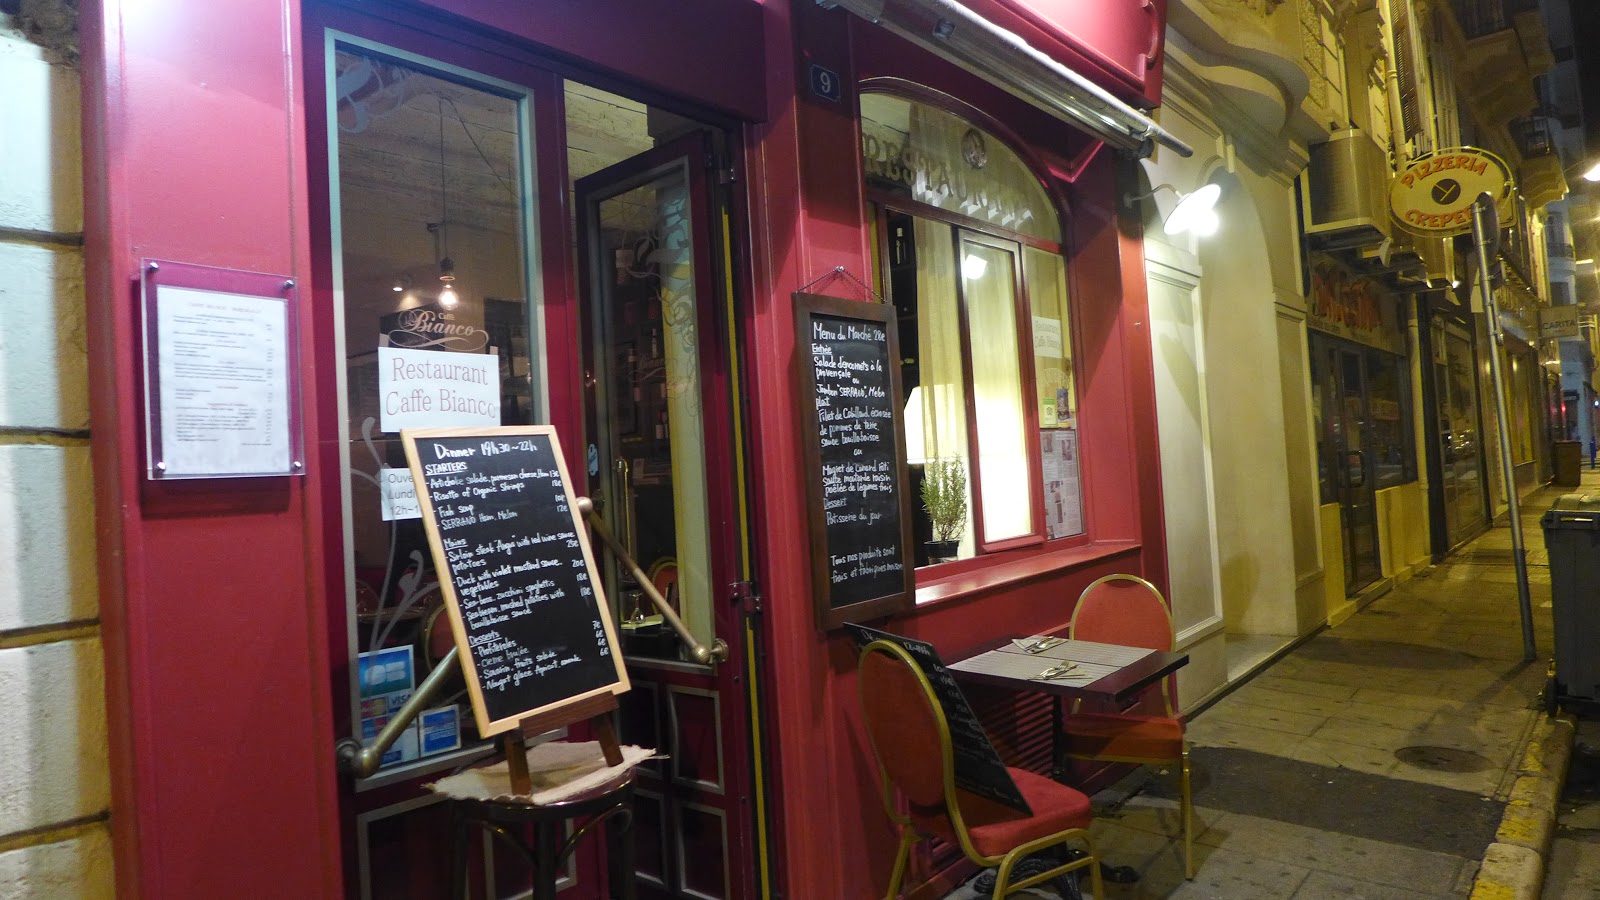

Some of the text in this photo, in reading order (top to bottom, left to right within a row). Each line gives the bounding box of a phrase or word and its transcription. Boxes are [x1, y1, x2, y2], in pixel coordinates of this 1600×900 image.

[819, 71, 832, 94] 9
[1400, 155, 1488, 189] PIZZERIA
[402, 309, 475, 337] Bianco
[813, 322, 836, 340] Menu
[837, 325, 846, 340] du
[847, 325, 872, 341] Marché
[811, 343, 832, 355] Entrée
[392, 357, 489, 386] Restaurant
[813, 355, 836, 369] Salade
[870, 360, 876, 371] à
[876, 360, 883, 372] la
[816, 384, 838, 397] Jambon
[868, 386, 886, 398] Melon
[386, 388, 497, 419] Caffe Bianco
[818, 409, 835, 422] Filet
[835, 407, 843, 420] de
[820, 424, 828, 436] de
[829, 425, 853, 438] pommes
[853, 419, 862, 430] de
[821, 438, 840, 447] sauce
[434, 444, 476, 459] Dinner
[853, 448, 863, 456] ou
[425, 462, 468, 474] STARTERS
[845, 461, 854, 473] de
[854, 459, 877, 473] Canard
[844, 472, 871, 483] moutarde
[872, 472, 891, 482] raisin
[433, 490, 459, 501] Risotto
[462, 487, 471, 497] of
[473, 487, 498, 499] Organic
[848, 482, 857, 492] de
[879, 482, 893, 494] frais
[438, 504, 455, 518] Fish
[458, 504, 474, 516] soup
[823, 497, 847, 510] Dessert
[441, 516, 477, 530] SERRANO
[498, 509, 517, 520] Melon
[859, 507, 868, 520] du
[867, 508, 882, 526] jour
[443, 538, 468, 550] Mains
[475, 543, 495, 555] steak
[516, 536, 530, 547] with
[531, 532, 541, 544] red
[541, 535, 557, 543] wine
[557, 532, 575, 540] sauce
[830, 554, 847, 567] Tous
[847, 553, 859, 563] nos
[882, 544, 896, 557] sont
[452, 559, 487, 575] potatoes
[456, 573, 476, 587] Duck
[478, 570, 491, 581] with
[492, 565, 511, 577] violet
[513, 559, 540, 573] mustard
[830, 569, 849, 584] frais
[850, 566, 858, 578] et
[460, 580, 499, 597] vegetables
[549, 588, 565, 600] with
[511, 609, 532, 618] sauce
[469, 630, 502, 647] Desserts
[486, 675, 511, 691] Nougat
